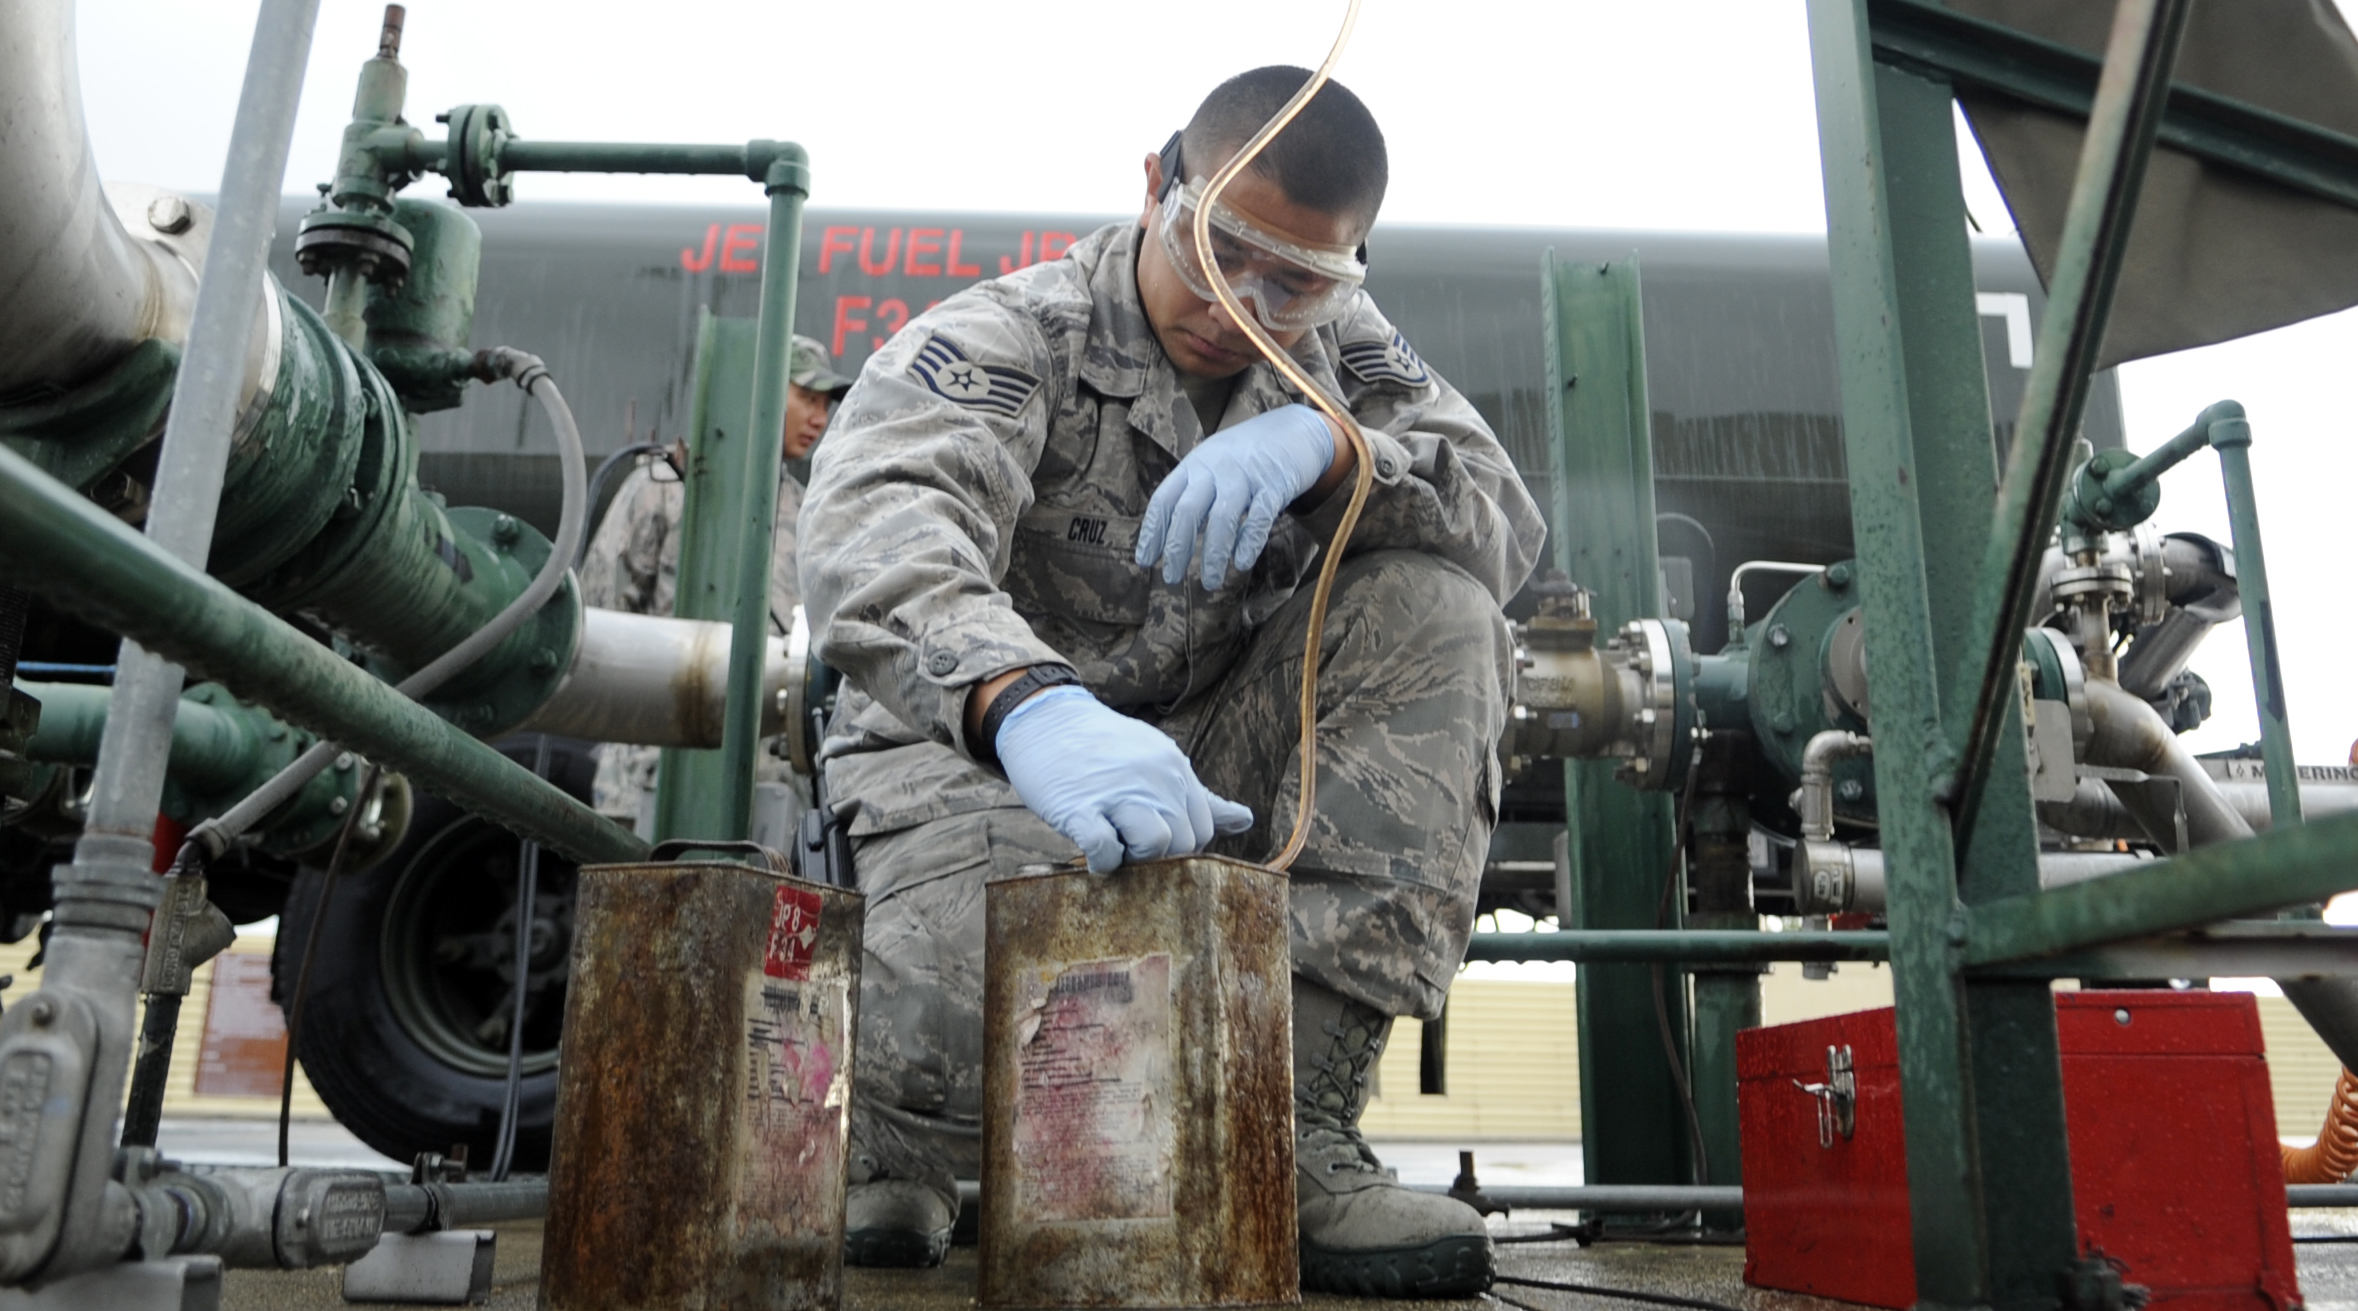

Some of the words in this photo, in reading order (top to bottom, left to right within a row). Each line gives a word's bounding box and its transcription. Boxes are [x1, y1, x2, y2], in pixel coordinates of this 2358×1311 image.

[681, 223, 766, 273] JE
[818, 226, 981, 277] FUEL
[832, 295, 940, 357] F3
[1067, 516, 1108, 545] CRUZ
